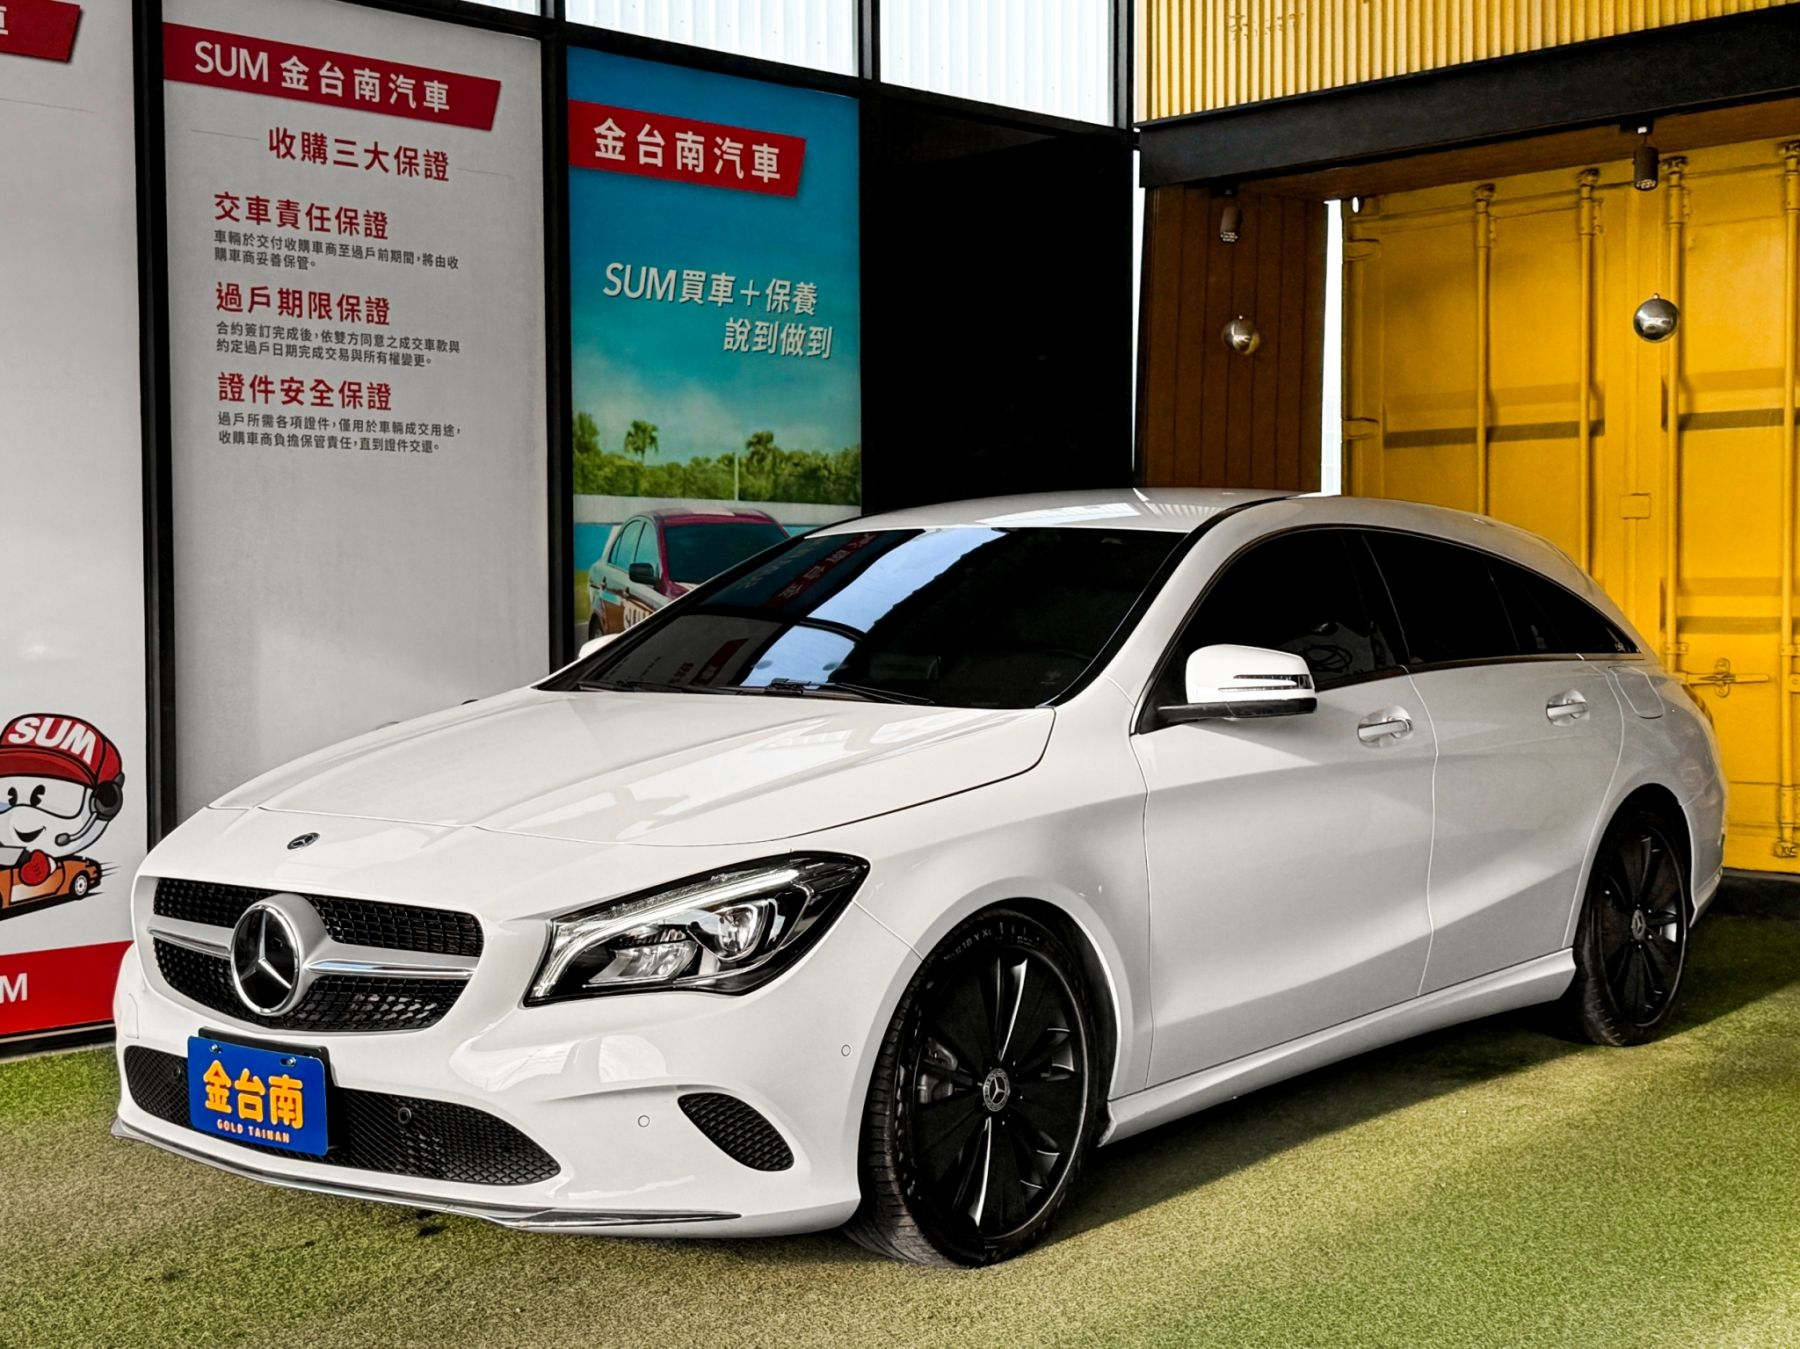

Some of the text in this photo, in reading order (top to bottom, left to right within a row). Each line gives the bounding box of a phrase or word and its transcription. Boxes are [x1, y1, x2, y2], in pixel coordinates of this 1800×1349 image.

[195, 41, 450, 113] SUM 金台南汽車
[269, 127, 450, 182] 收購三大保證
[593, 118, 781, 183] 金台南汽車
[214, 192, 388, 240] 交車責任保證
[216, 282, 390, 325] 過戶期限保證
[723, 317, 832, 359] 說到做到
[218, 372, 391, 410] 證件安全保證
[8, 717, 97, 766] SUM
[203, 1060, 303, 1129] 金台南
[217, 1119, 290, 1143] GOLD TAINAN
